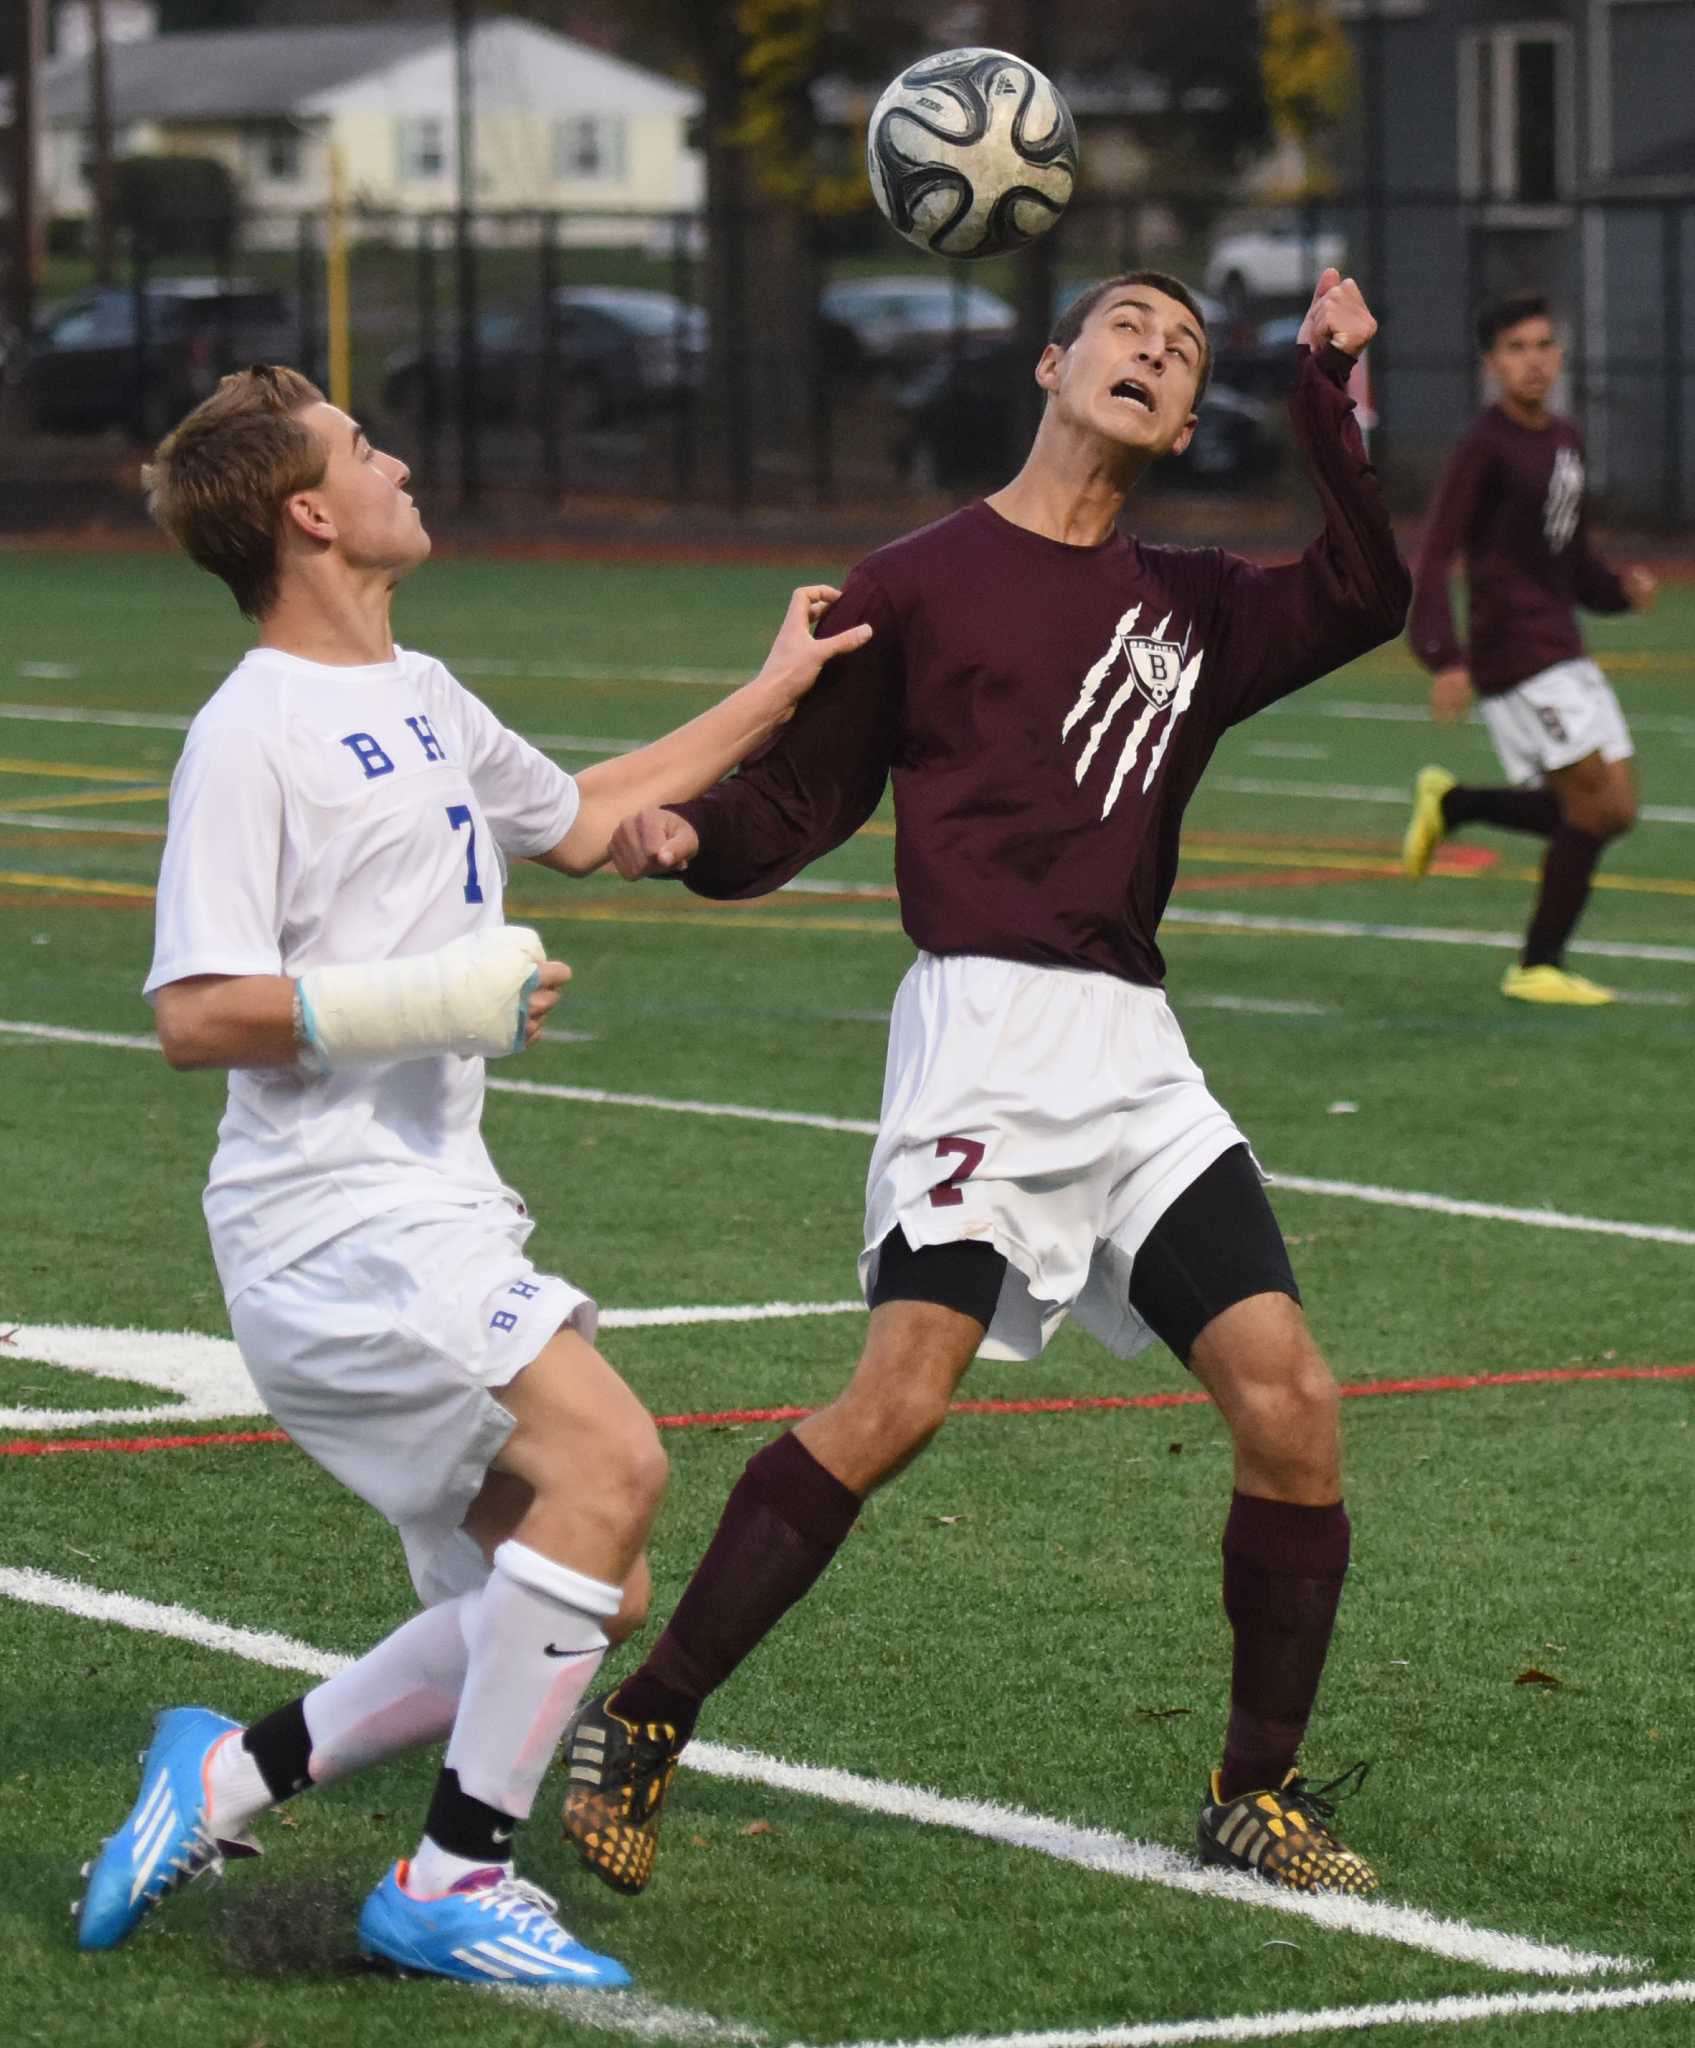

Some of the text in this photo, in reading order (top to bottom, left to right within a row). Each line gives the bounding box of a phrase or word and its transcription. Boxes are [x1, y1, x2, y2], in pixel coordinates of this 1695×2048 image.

[1149, 655, 1167, 680] B
[340, 715, 446, 780] B H
[446, 805, 483, 903] 7
[490, 1281, 540, 1333] B H
